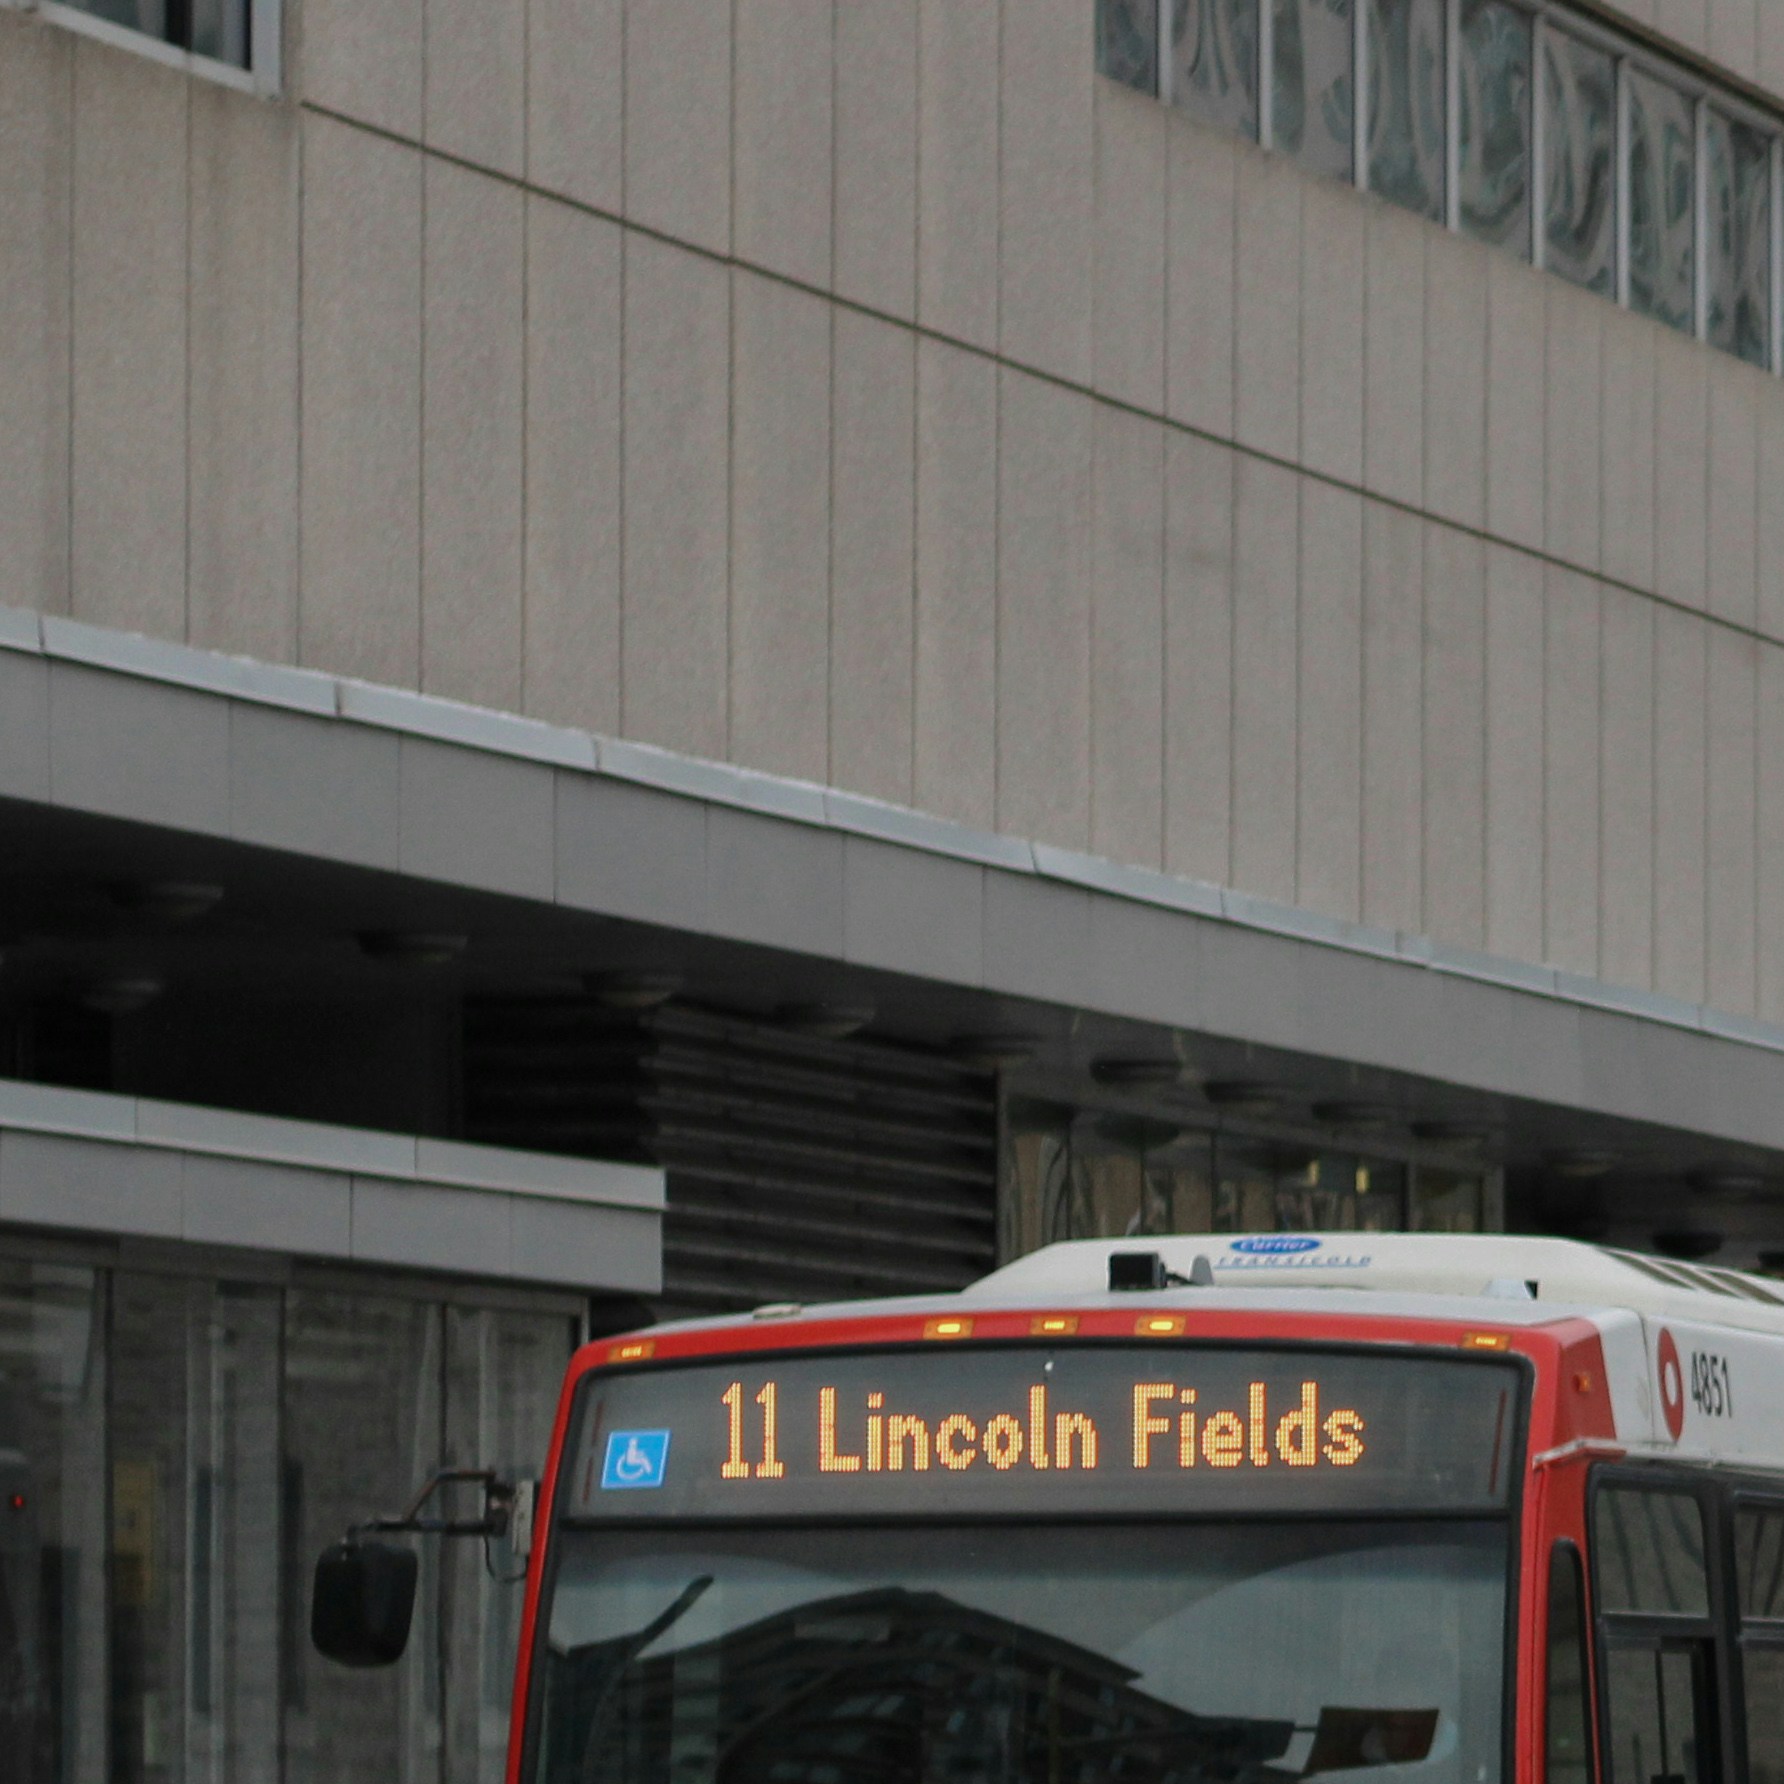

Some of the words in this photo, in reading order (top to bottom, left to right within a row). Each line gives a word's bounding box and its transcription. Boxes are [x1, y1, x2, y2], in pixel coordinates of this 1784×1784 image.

[1691, 1351, 1732, 1418] 4851
[720, 1382, 784, 1478] 11
[818, 1385, 1097, 1471] Lincoln
[1133, 1381, 1365, 1468] Fields
